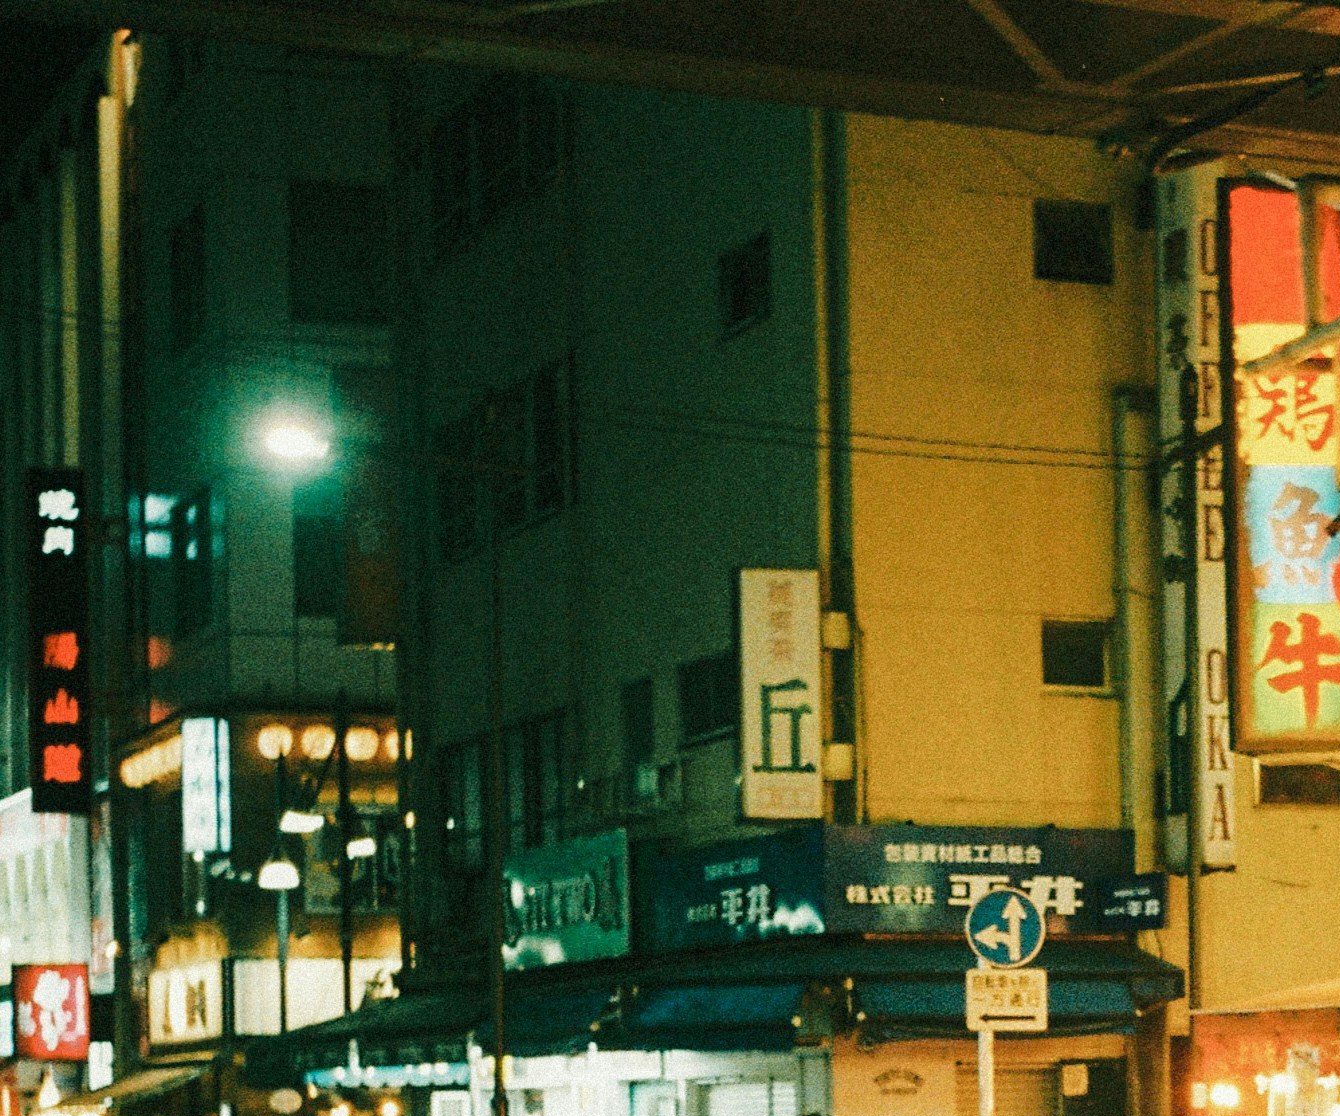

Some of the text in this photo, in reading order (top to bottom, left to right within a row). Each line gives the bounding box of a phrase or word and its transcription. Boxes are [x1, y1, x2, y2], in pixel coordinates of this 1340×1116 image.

[1207, 648, 1231, 842] OKA
[846, 883, 936, 906] 株式会社
